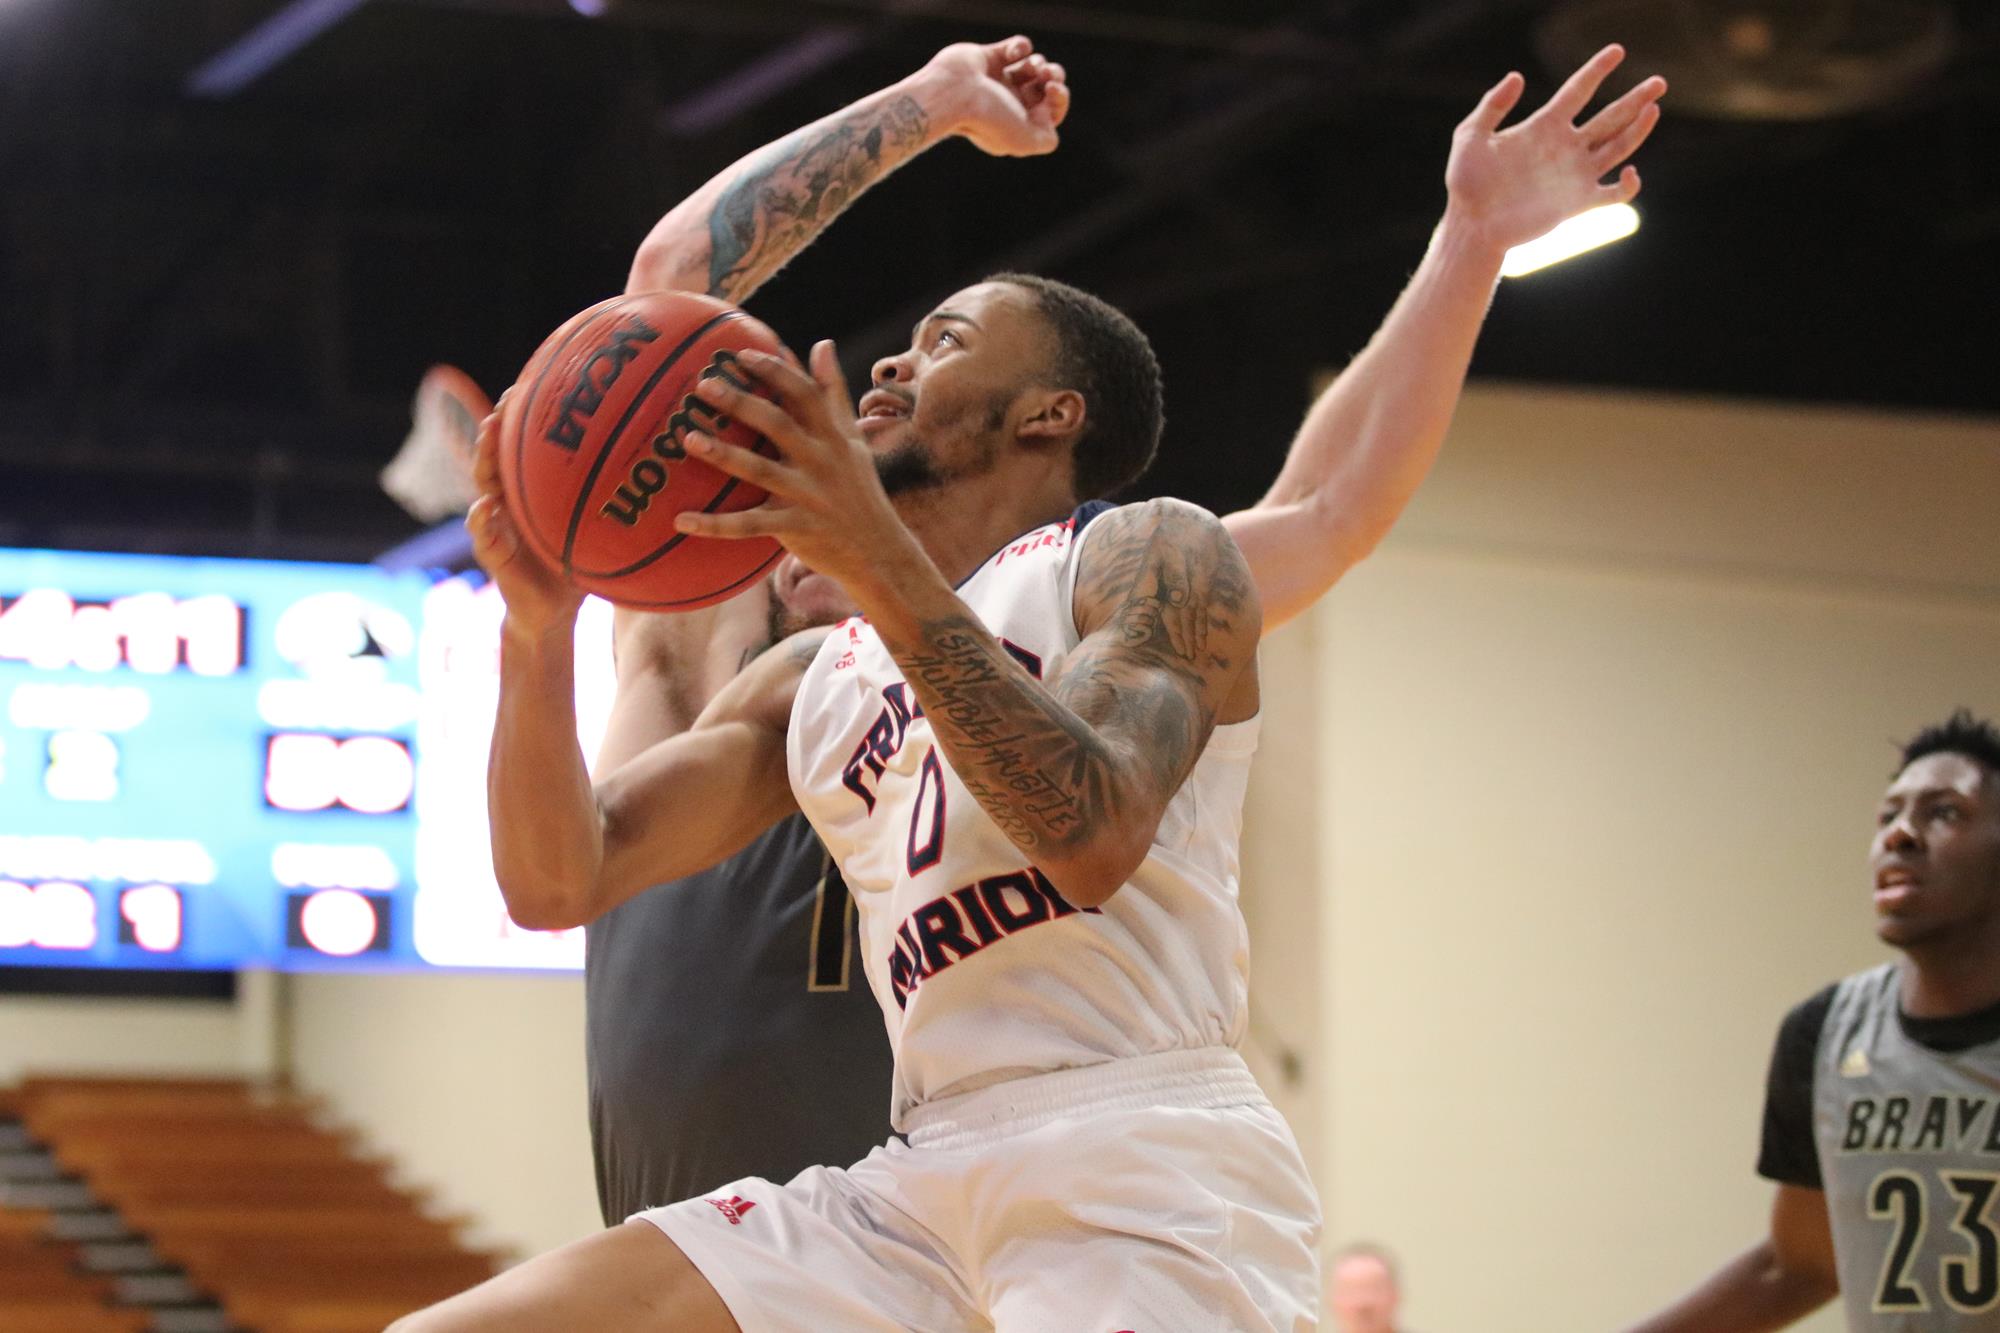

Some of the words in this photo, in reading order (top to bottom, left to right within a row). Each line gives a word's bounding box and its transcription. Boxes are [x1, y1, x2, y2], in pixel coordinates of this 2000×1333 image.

[544, 316, 662, 452] NCAA
[907, 744, 946, 879] 0
[1869, 1170, 2000, 1313] 23
